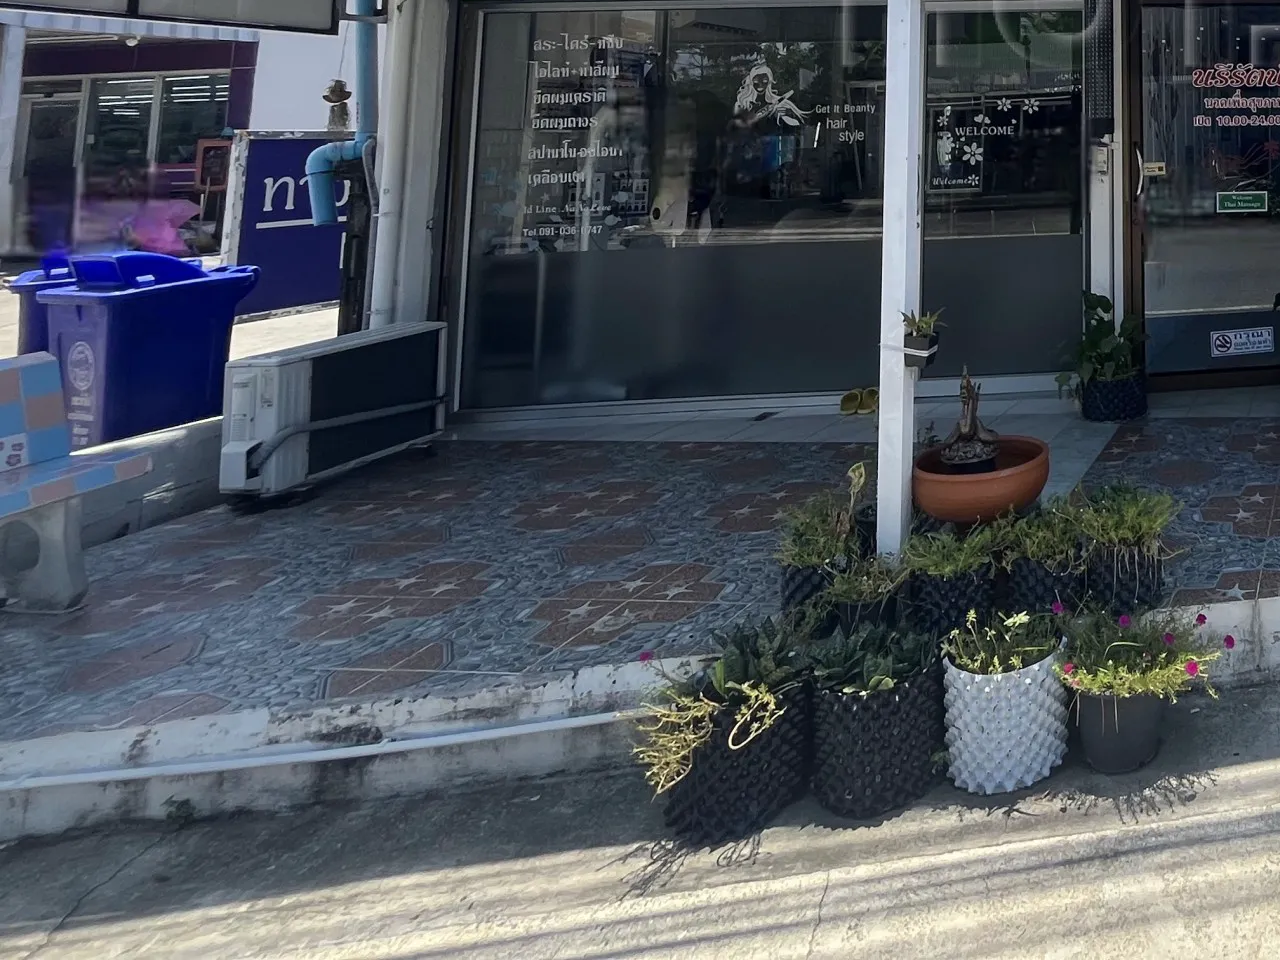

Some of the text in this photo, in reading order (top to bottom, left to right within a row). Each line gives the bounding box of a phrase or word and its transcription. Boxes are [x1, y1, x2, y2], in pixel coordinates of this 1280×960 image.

[816, 104, 830, 113] Get
[827, 117, 848, 129] hair
[955, 126, 1015, 136] WELCOME
[839, 130, 864, 144] style
[932, 176, 969, 185] Welcome
